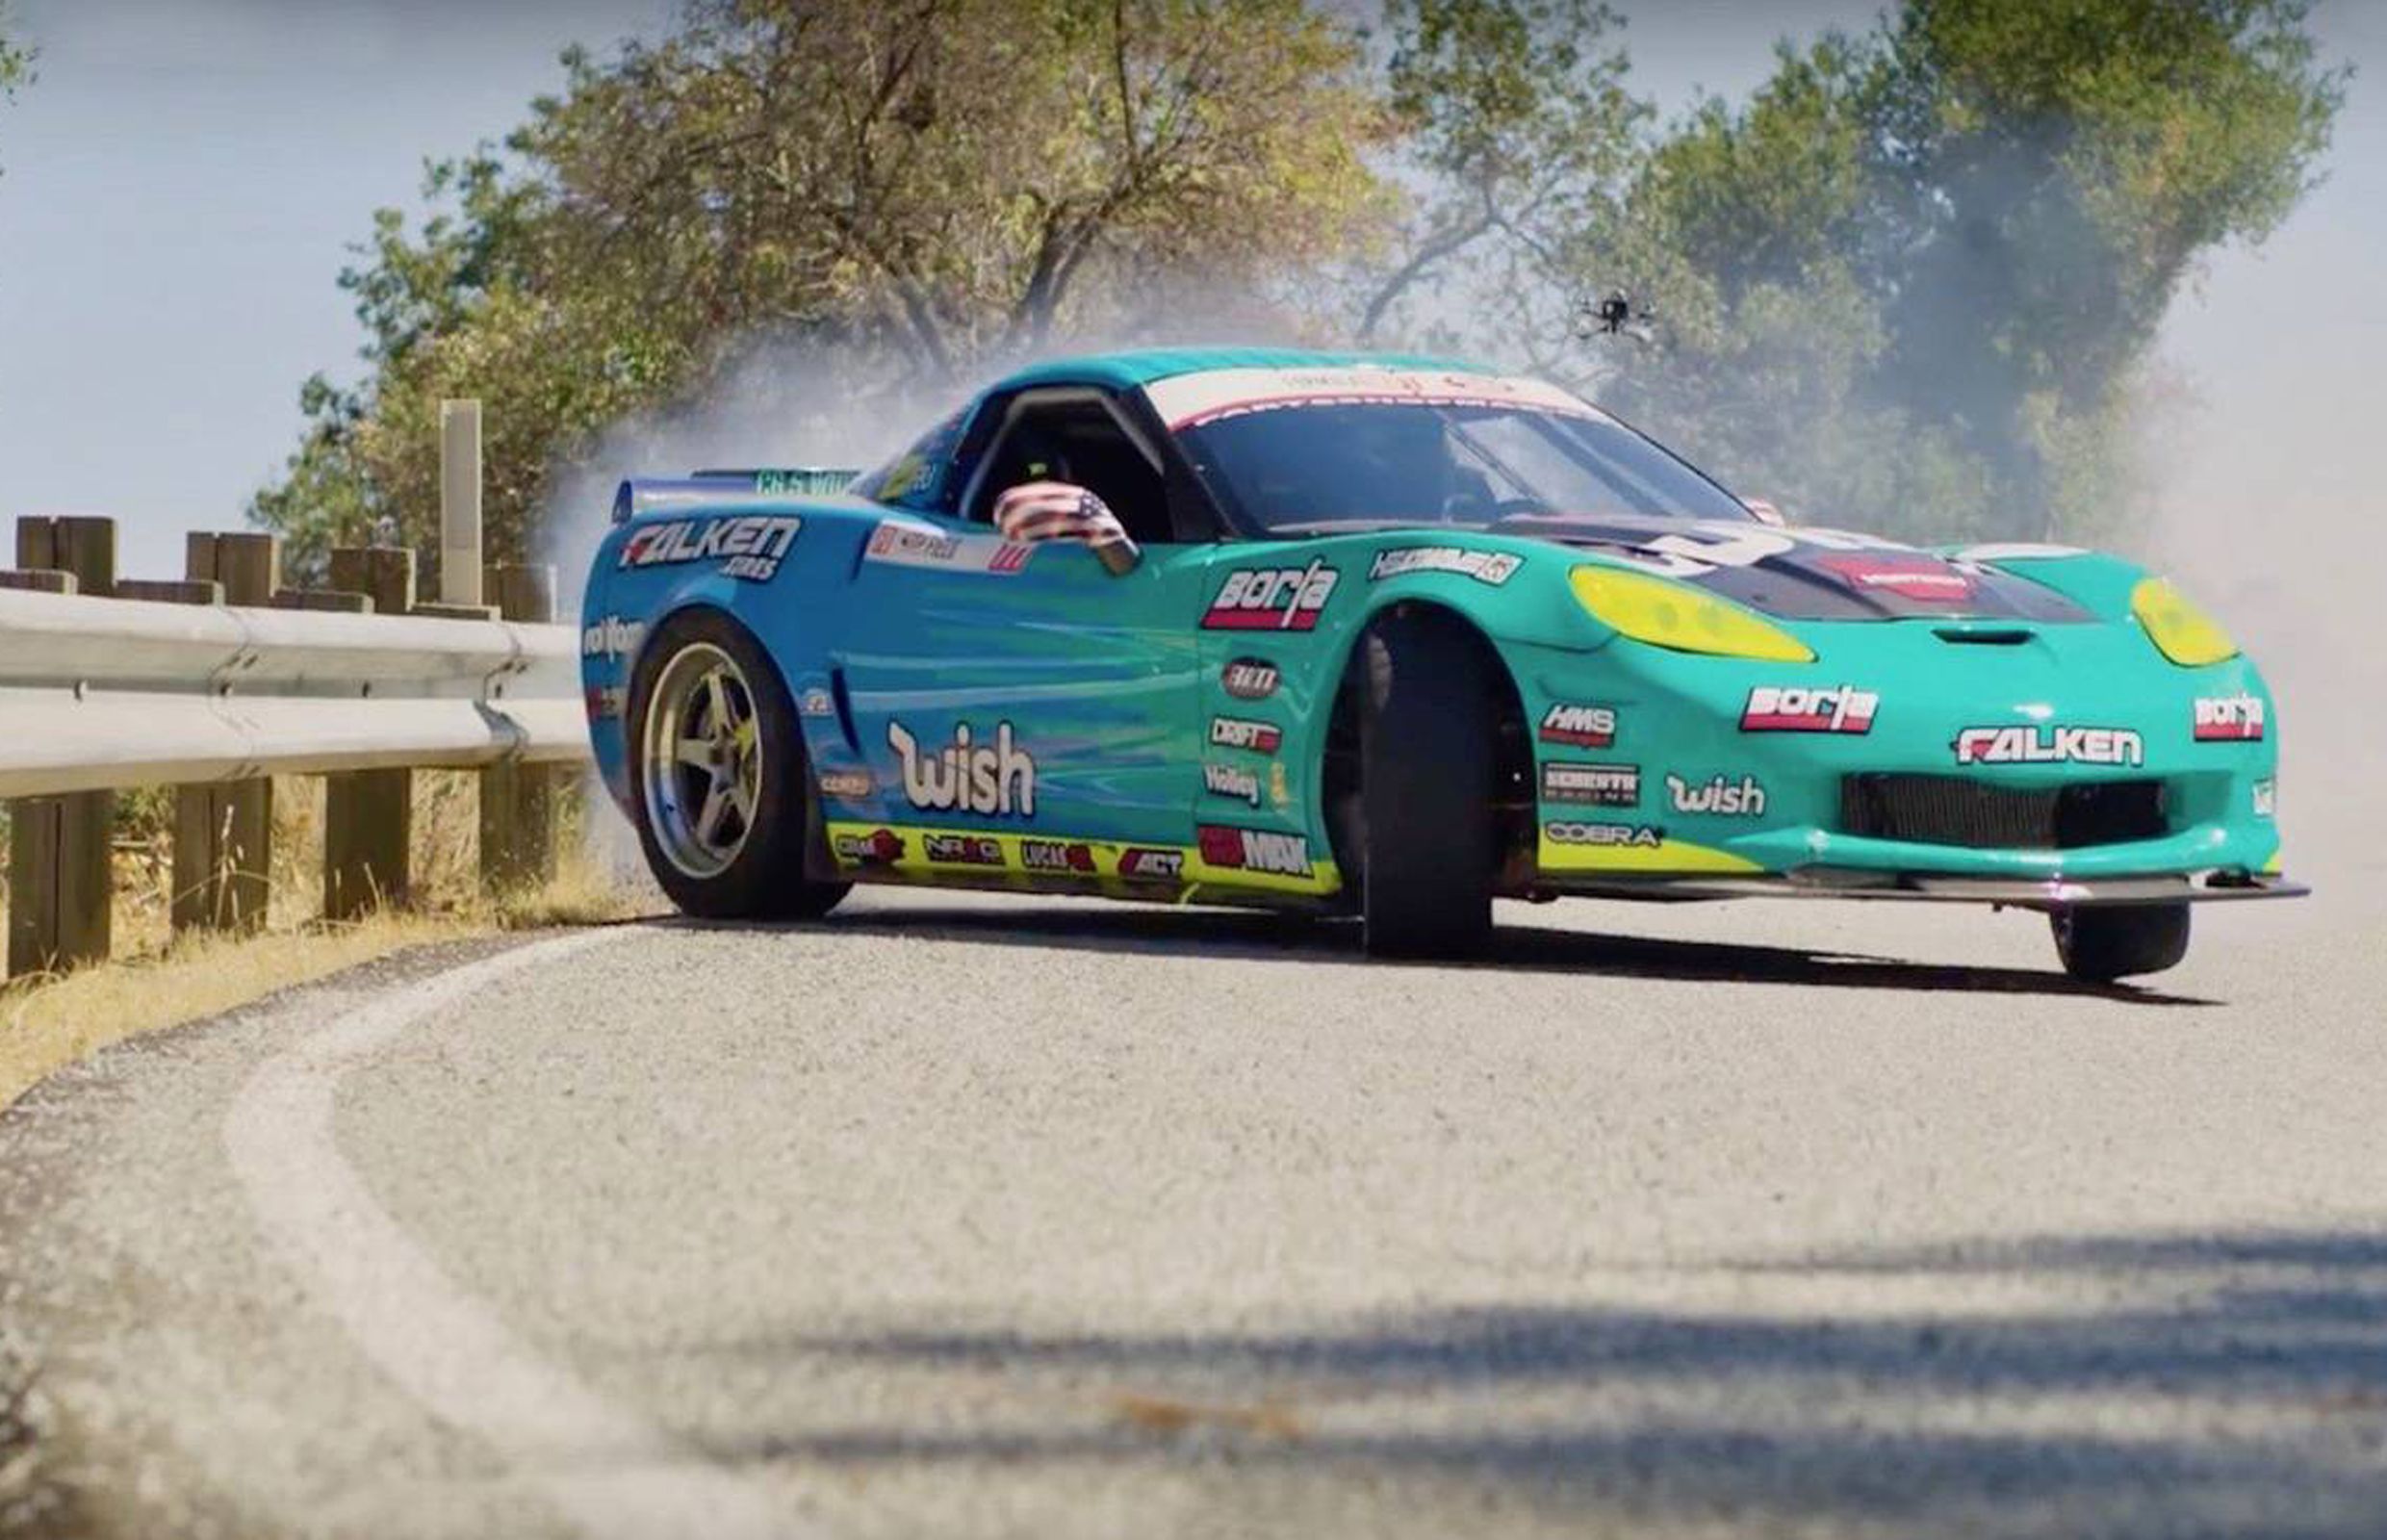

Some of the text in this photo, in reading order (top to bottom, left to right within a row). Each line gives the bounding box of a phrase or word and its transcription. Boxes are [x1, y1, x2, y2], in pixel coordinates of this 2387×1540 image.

[619, 516, 801, 568] FALKEN
[1958, 727, 2143, 764] FALKEN
[1547, 822, 1657, 846] COBRA
